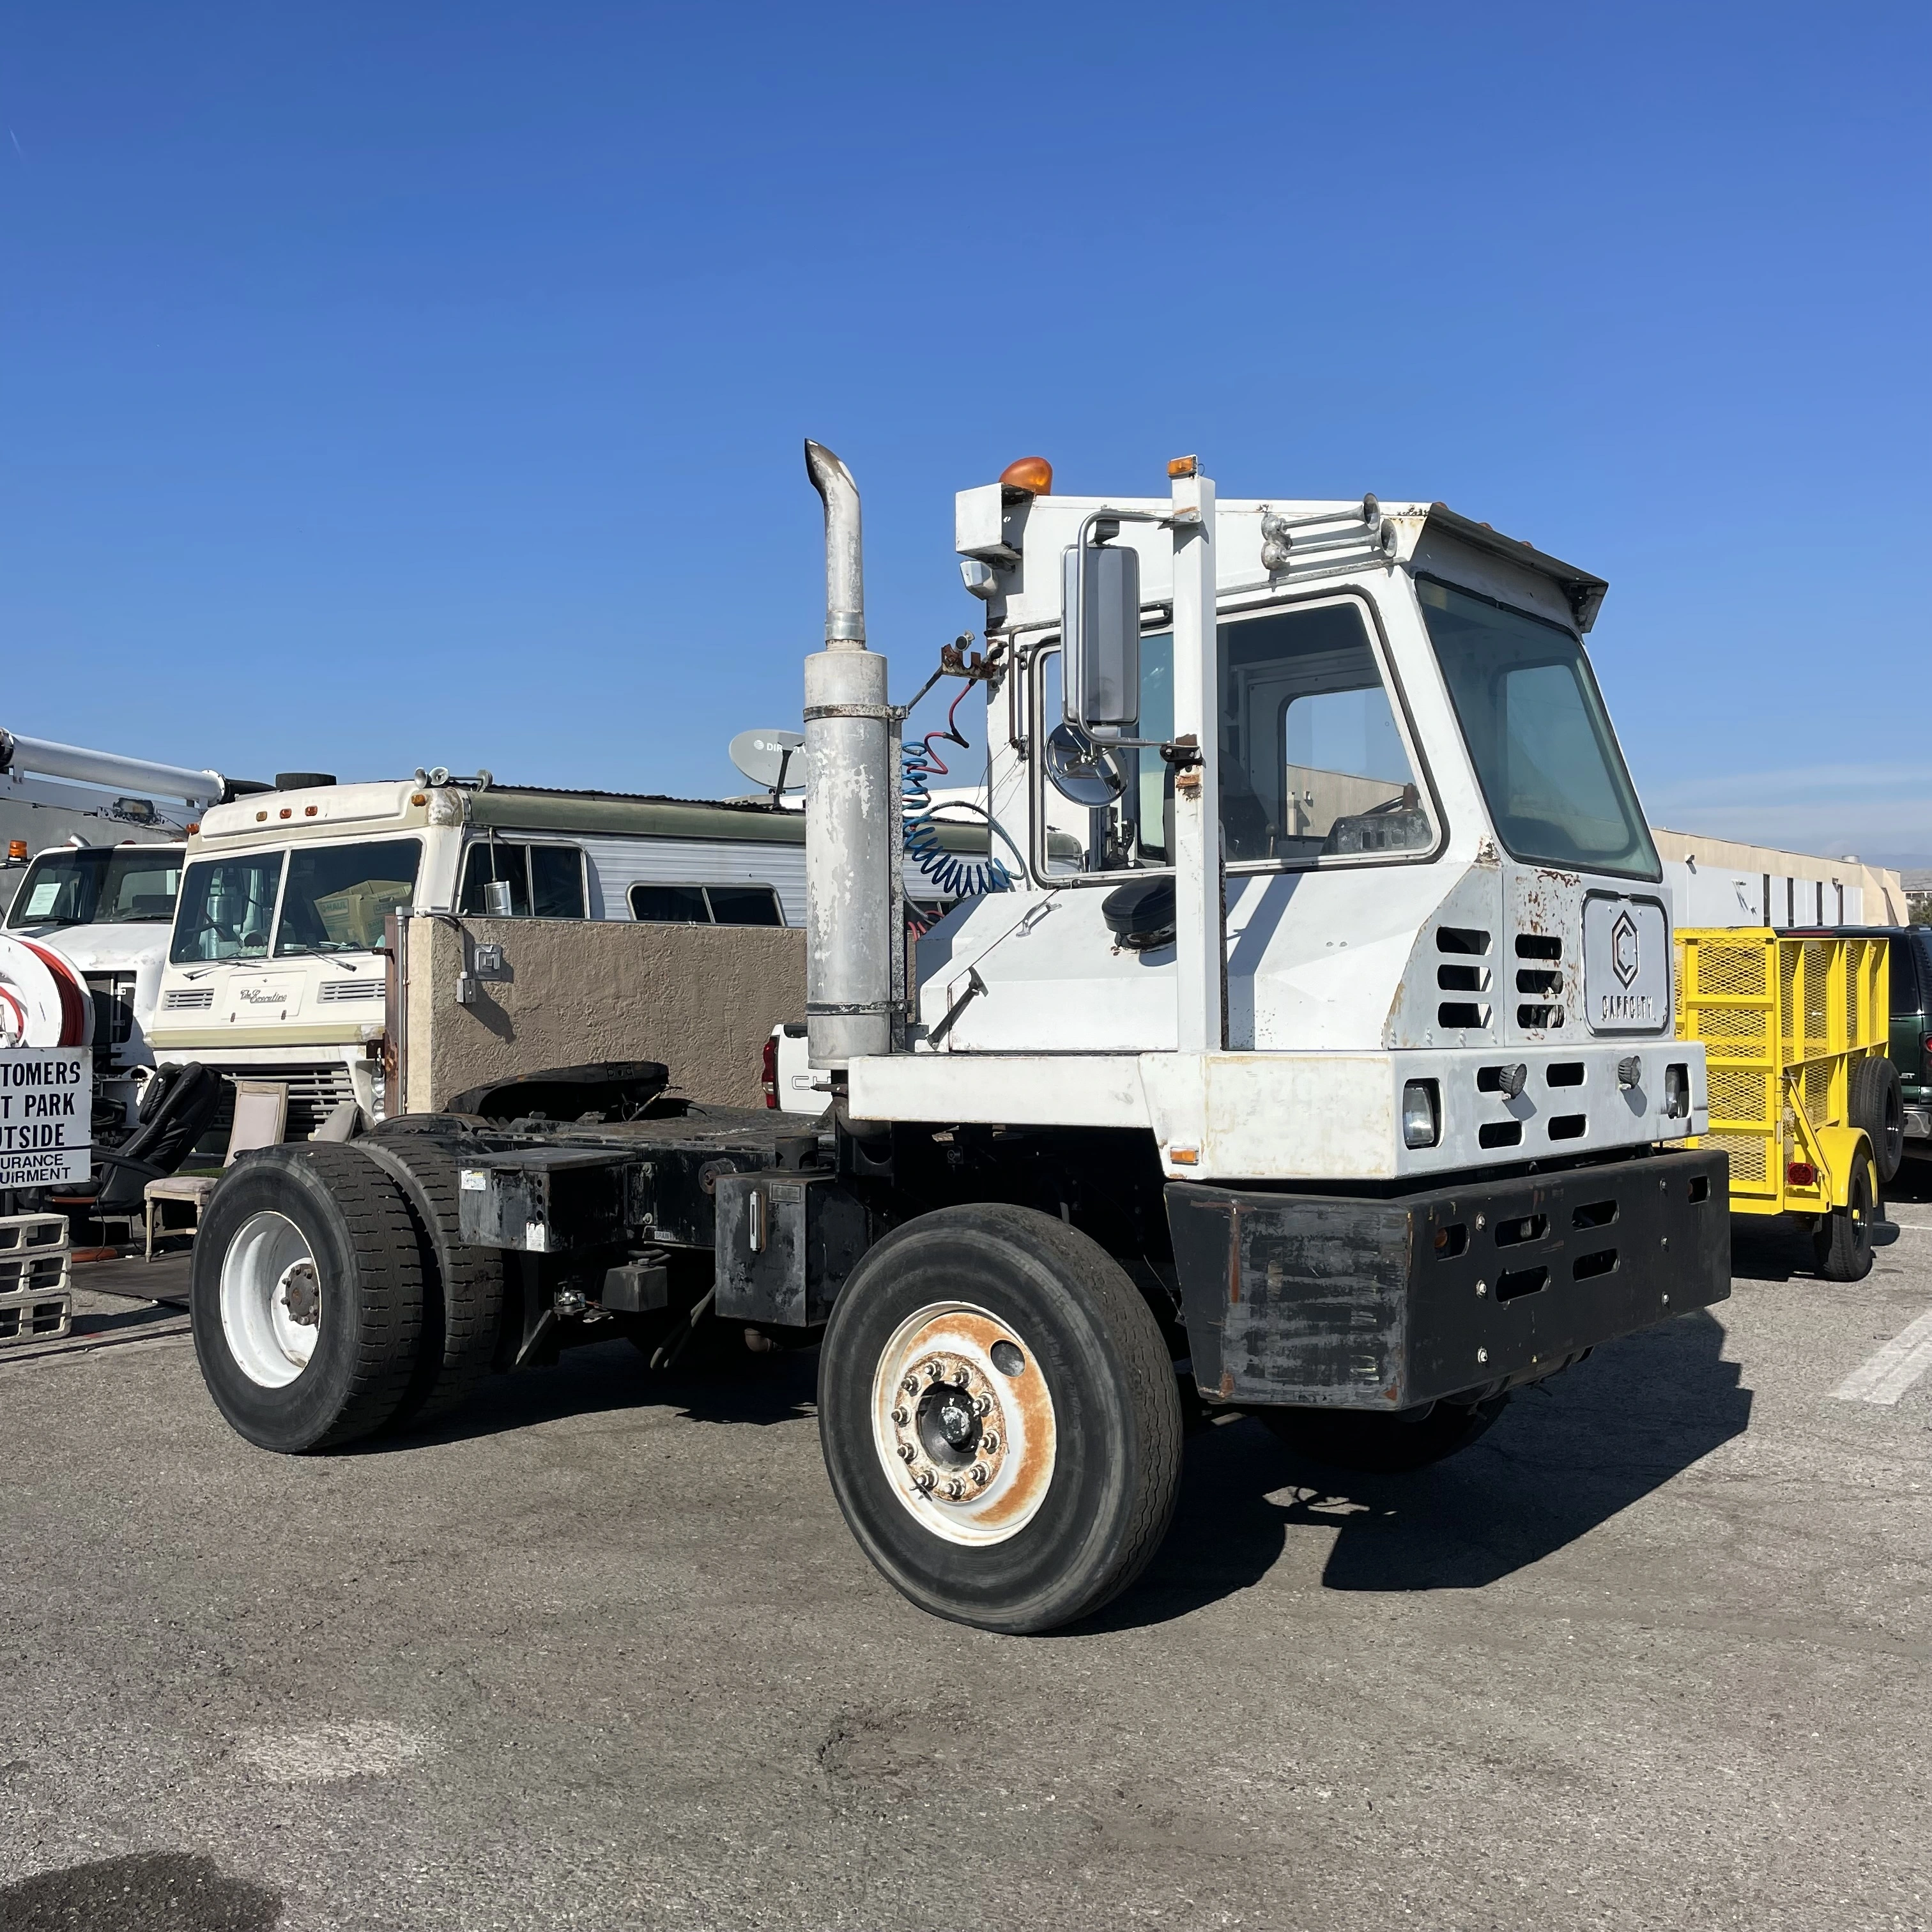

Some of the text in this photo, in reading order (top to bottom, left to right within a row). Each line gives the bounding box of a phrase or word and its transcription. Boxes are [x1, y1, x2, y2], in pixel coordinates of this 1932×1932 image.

[1602, 995, 1653, 1019] CAPACITY
[0, 1061, 81, 1087] TOMERS
[25, 1092, 75, 1117] PARK
[1, 1153, 64, 1169] URANCE
